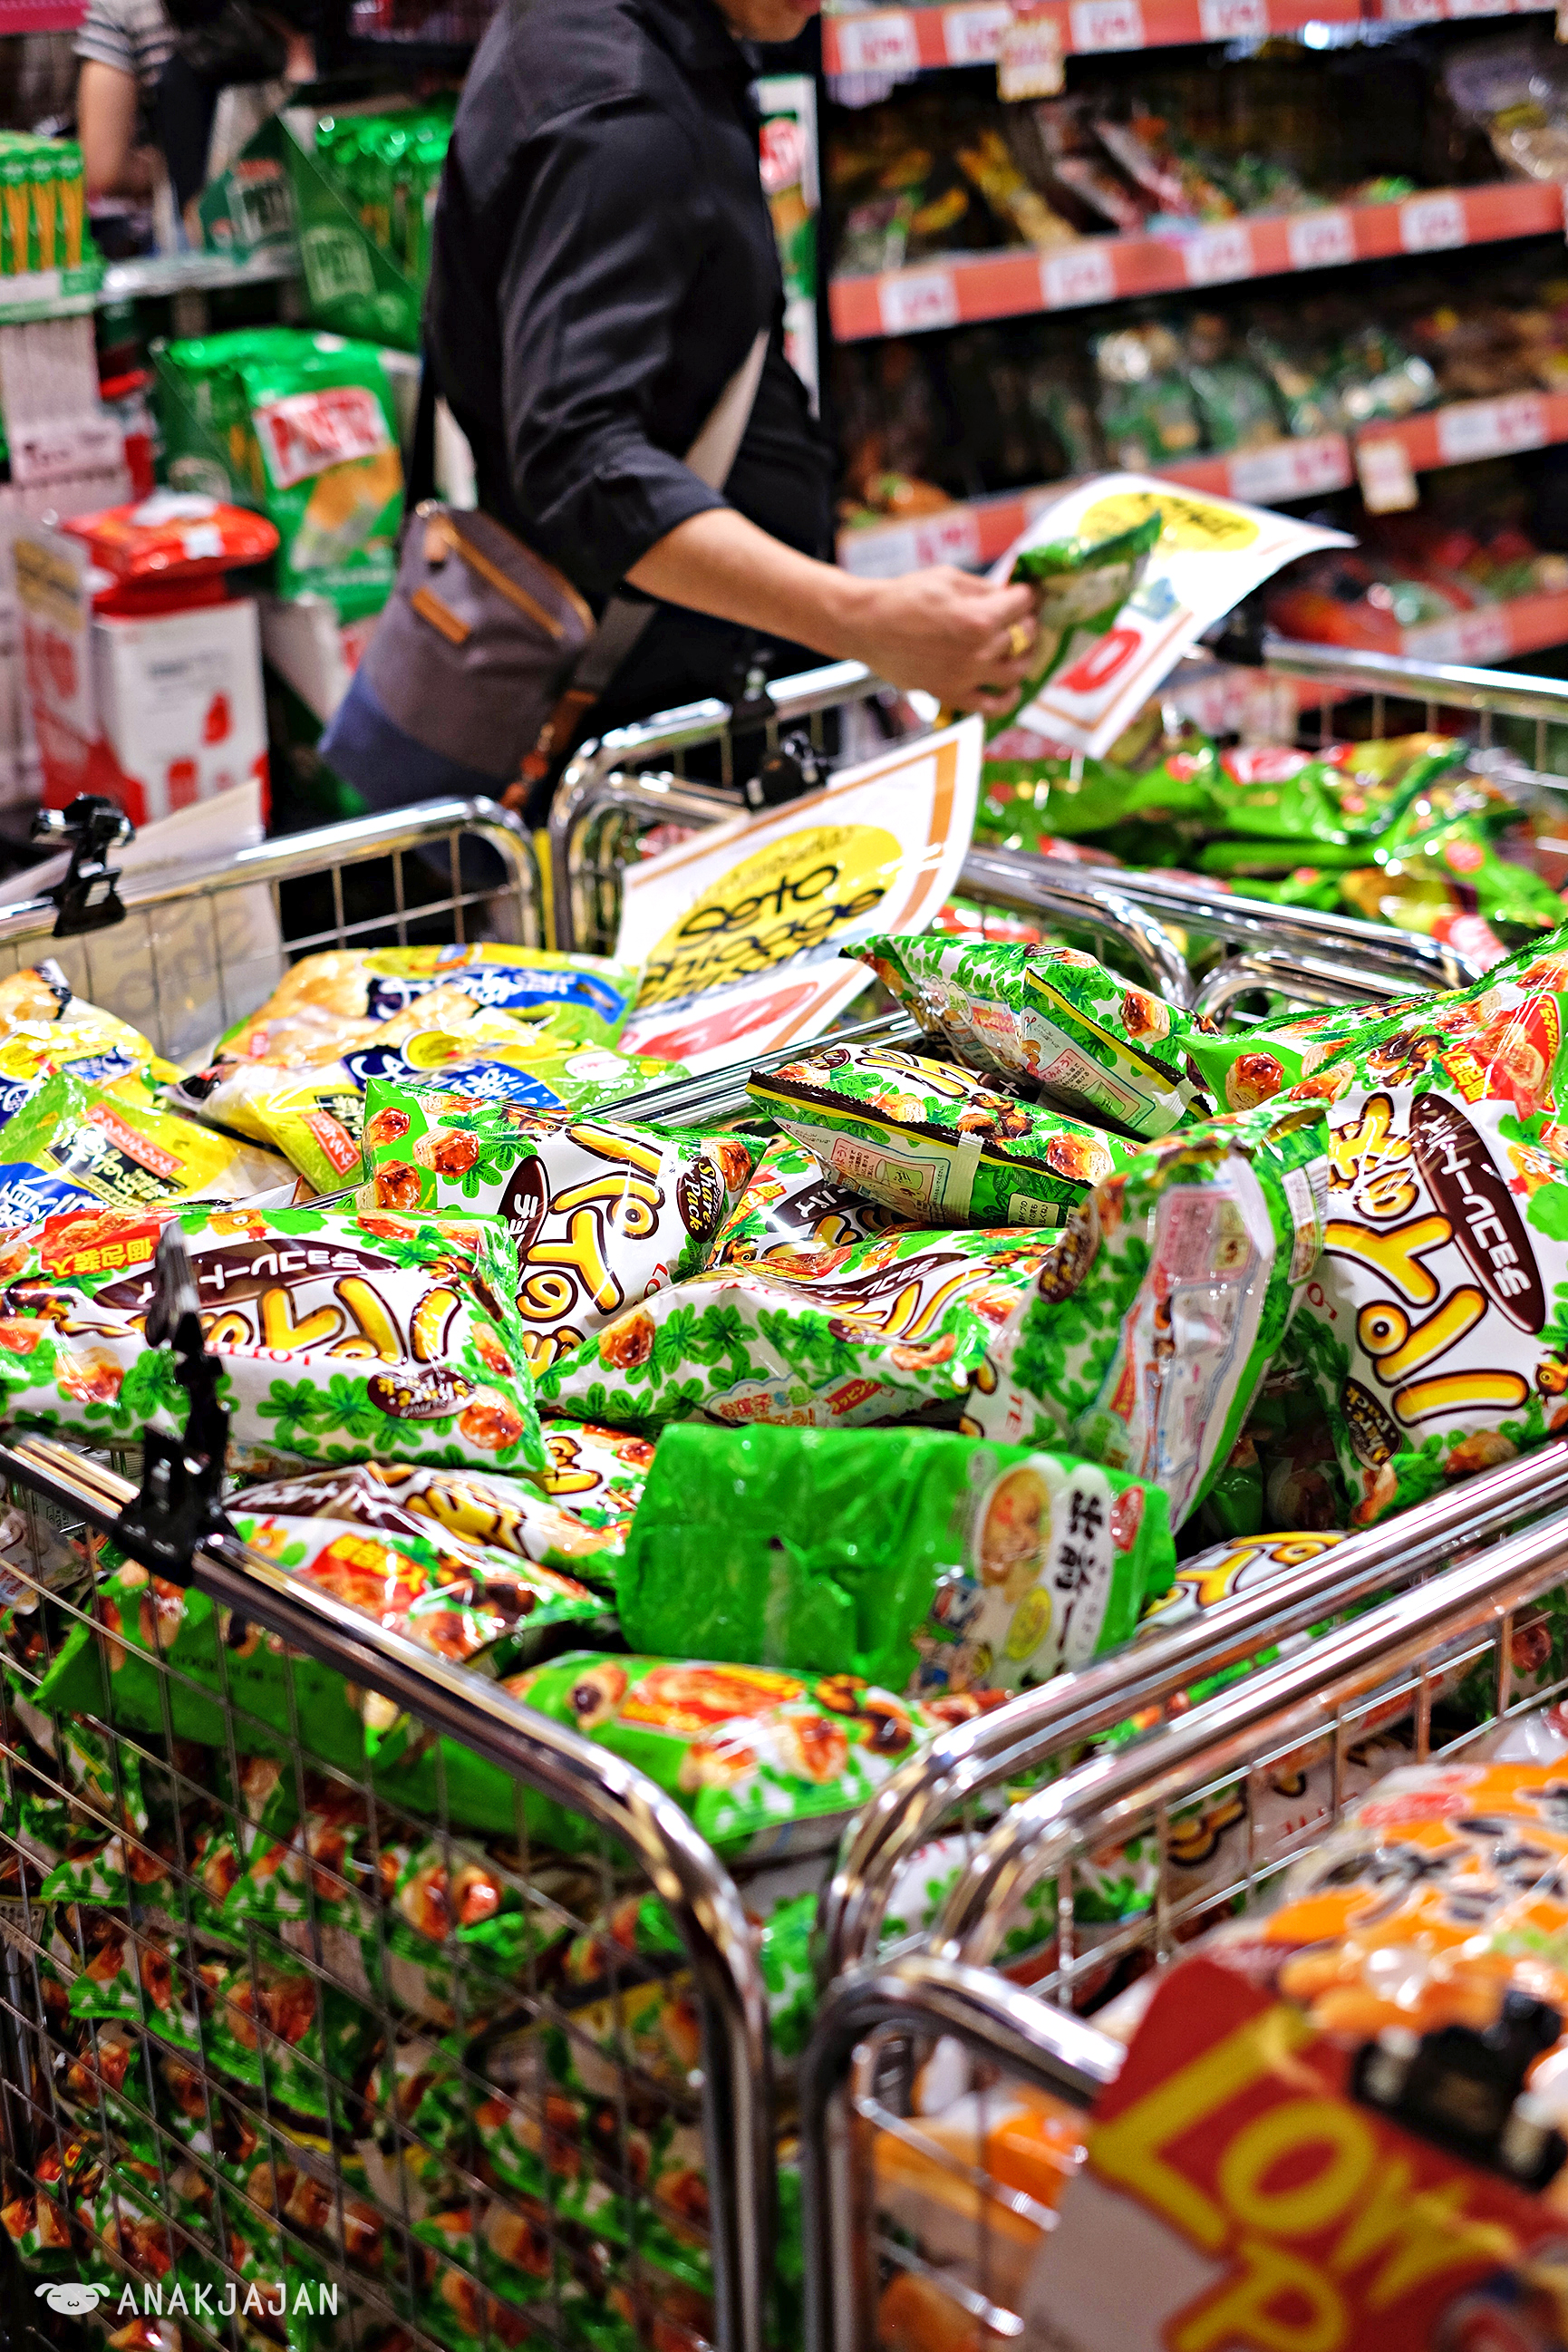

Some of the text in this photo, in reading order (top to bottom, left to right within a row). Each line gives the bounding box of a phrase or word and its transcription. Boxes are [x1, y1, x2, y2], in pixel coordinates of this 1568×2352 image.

[685, 1178, 700, 1231] Pack
[699, 1163, 715, 1223] Share
[49, 1234, 155, 1274] 個包装入
[1052, 1489, 1104, 1664] 出前一
